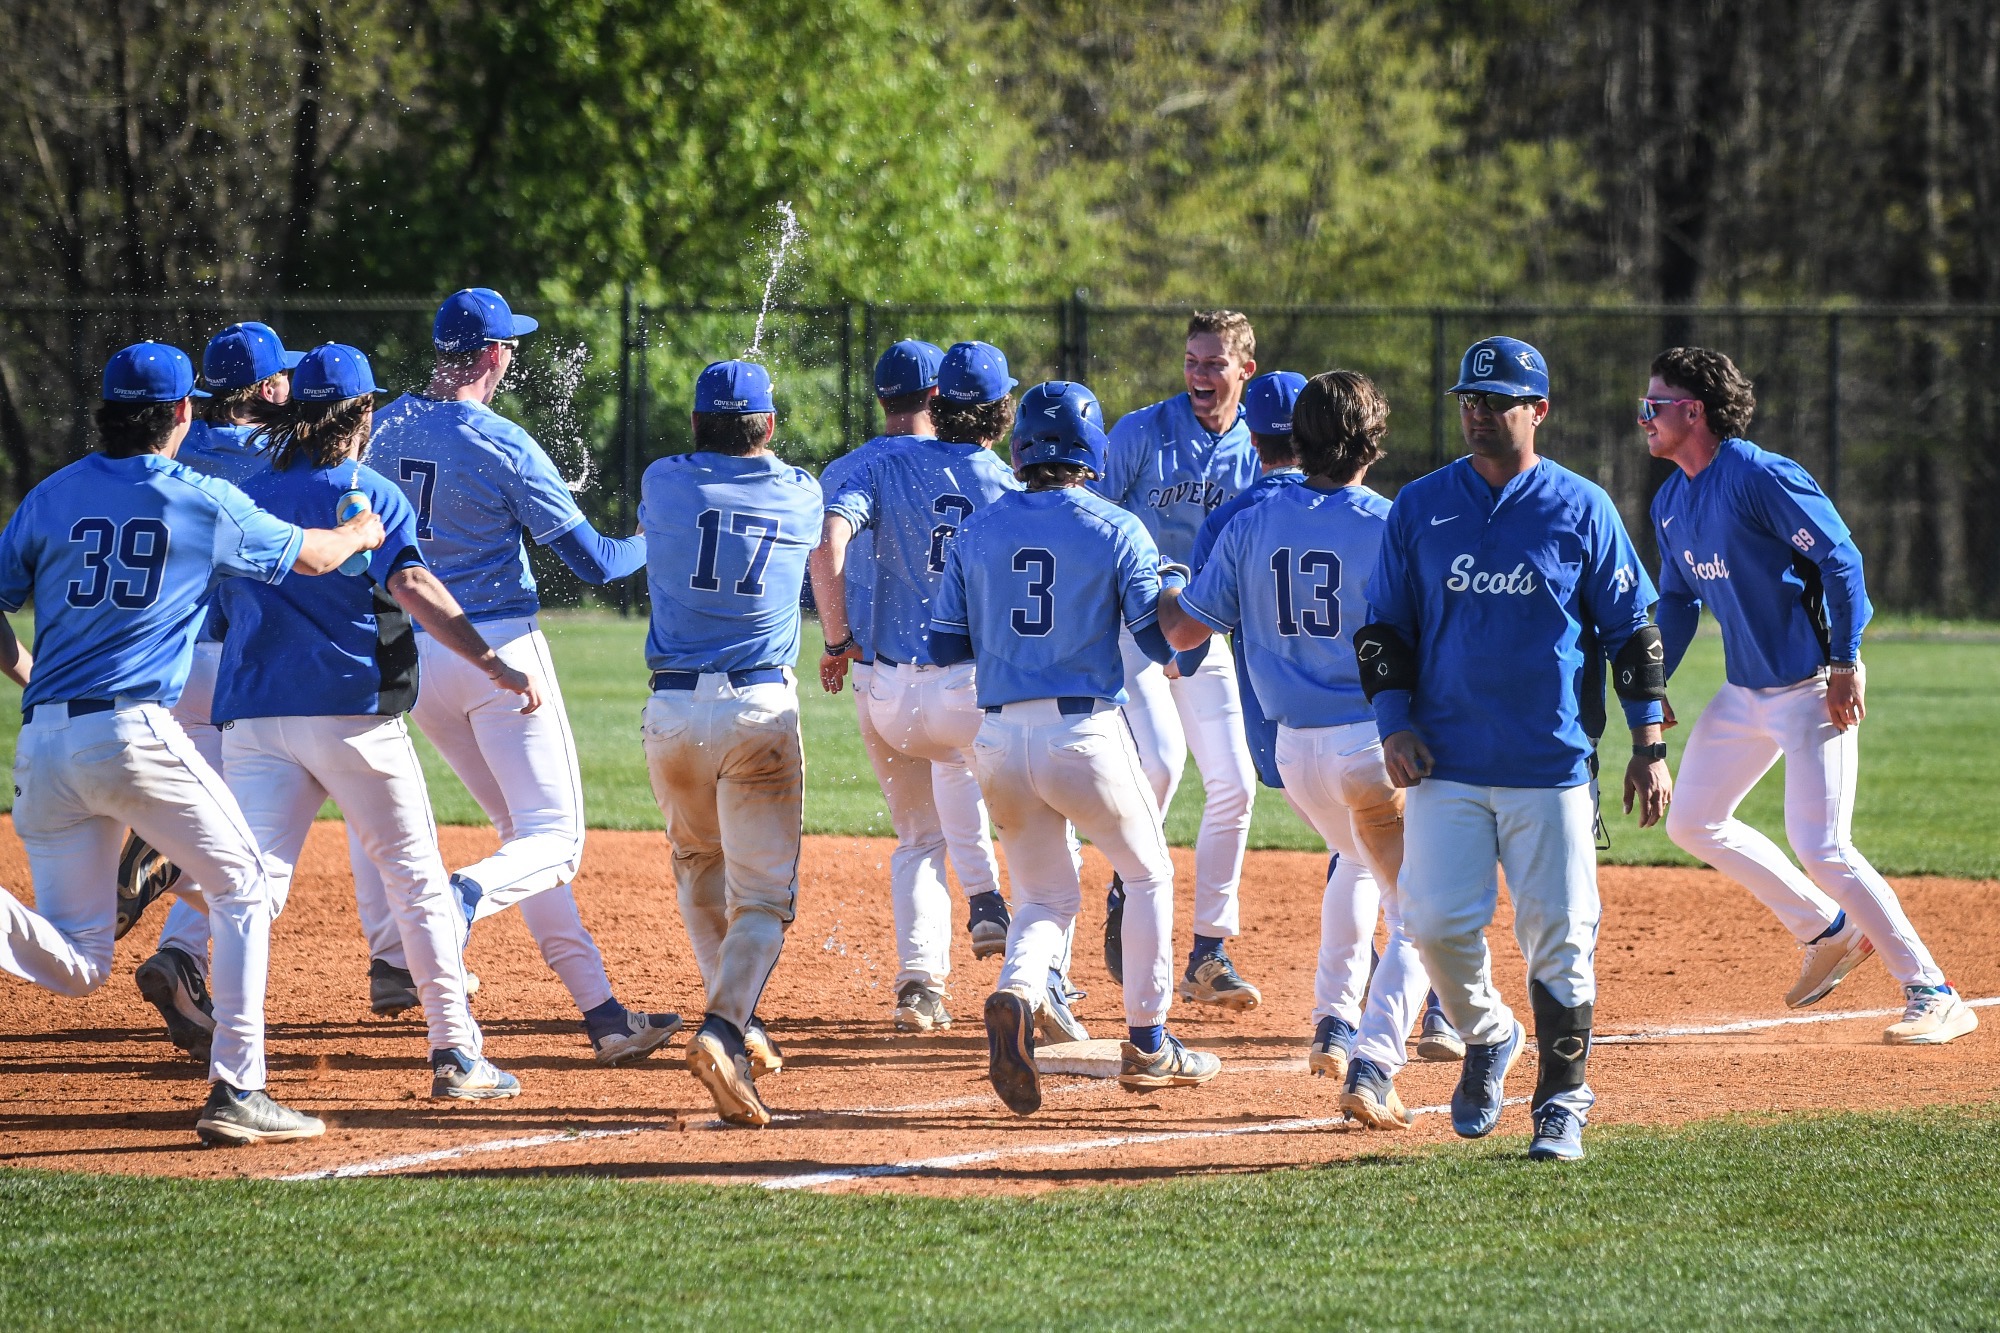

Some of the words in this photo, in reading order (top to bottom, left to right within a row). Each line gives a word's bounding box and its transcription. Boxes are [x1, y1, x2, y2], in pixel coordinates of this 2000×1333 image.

[1473, 348, 1496, 377] C
[113, 387, 147, 396] COVENANT
[303, 387, 335, 395] COVENANT
[713, 399, 748, 407] COVENANT
[949, 388, 980, 397] COVENANT
[1049, 444, 1056, 456] 3
[399, 456, 438, 541] 7
[689, 507, 781, 598] 17
[1791, 527, 1816, 552] 99
[64, 516, 172, 611] 39
[1446, 553, 1538, 596] Scots
[1683, 549, 1730, 581] Scots
[1010, 546, 1057, 638] 3
[1269, 546, 1343, 640] 13
